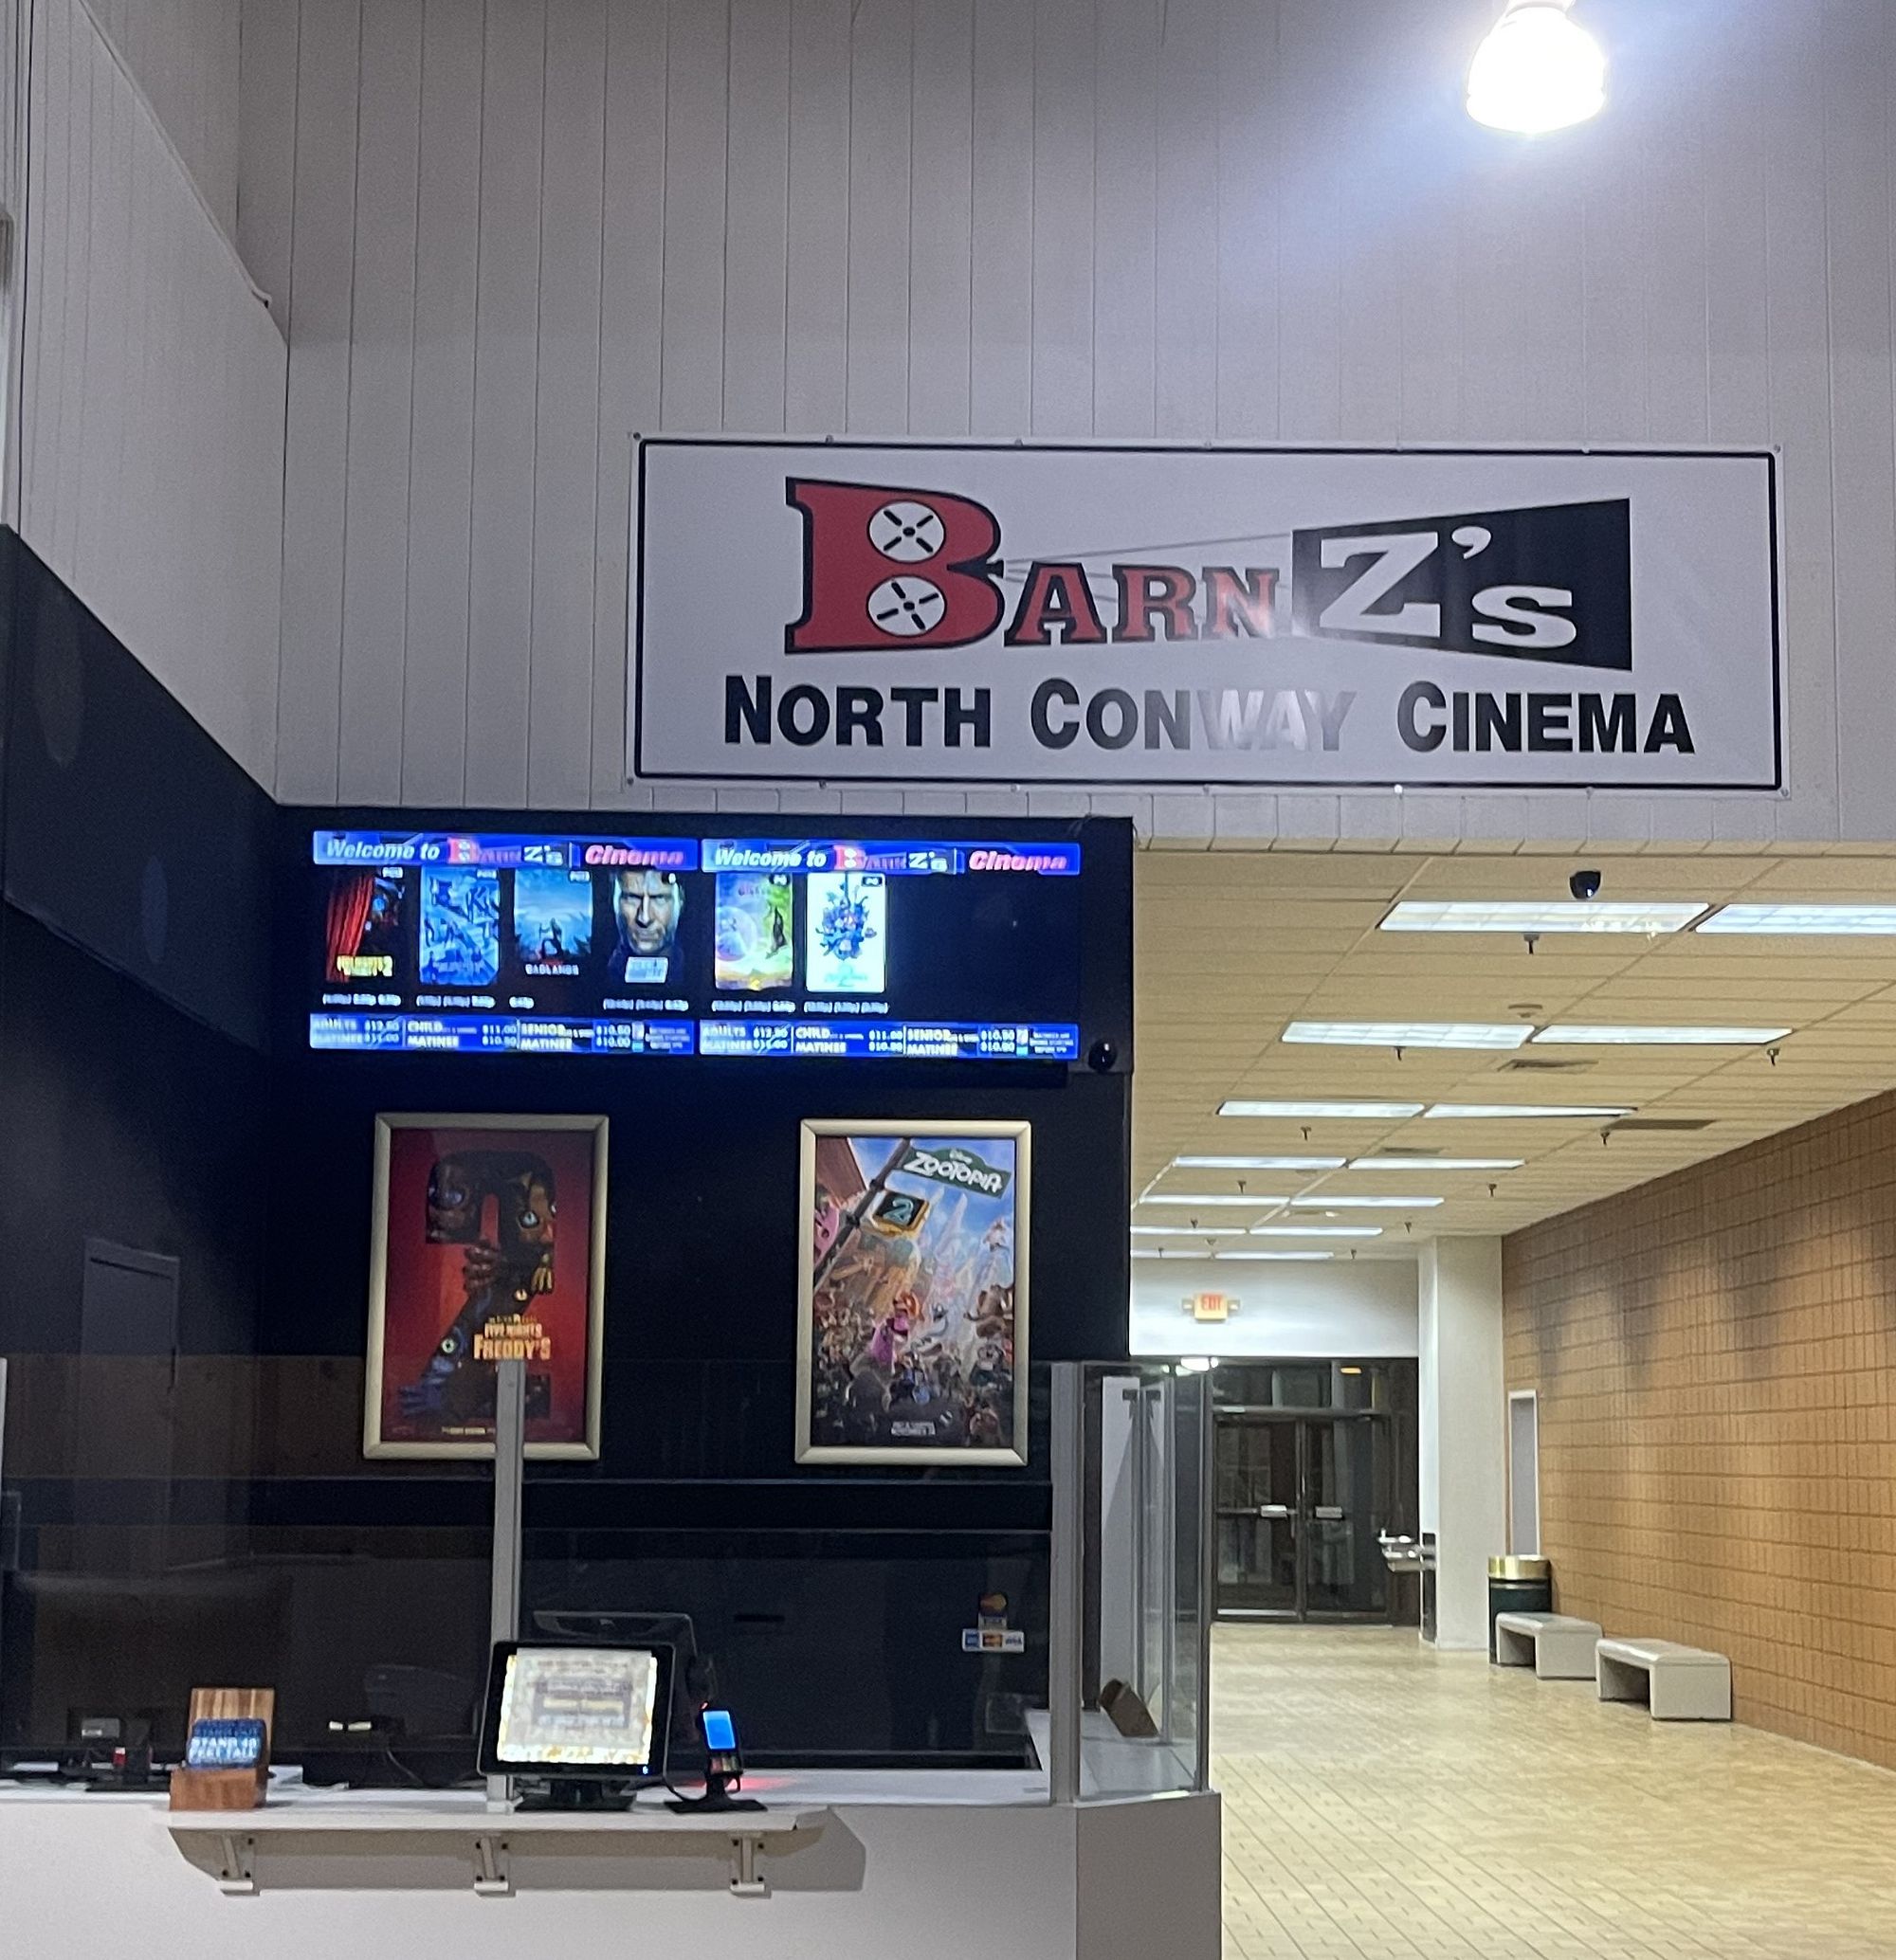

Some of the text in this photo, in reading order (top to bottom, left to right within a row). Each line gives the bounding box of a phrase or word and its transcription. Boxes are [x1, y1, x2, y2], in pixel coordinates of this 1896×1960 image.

[723, 674, 1697, 754] NORTH CONWAY CINEMA
[326, 838, 415, 860] Welcome
[419, 843, 441, 861] to
[584, 844, 684, 866] Cinema
[715, 847, 803, 867] Welcome
[806, 850, 828, 868] to
[968, 850, 1067, 871] Cinema
[407, 1021, 444, 1033] CHILD
[794, 1025, 830, 1039] CHILD
[907, 1028, 951, 1041] SENIOR
[903, 1151, 1003, 1193] ZOOTOPIA
[883, 1197, 914, 1225] 2
[1200, 1293, 1223, 1311] EXIT
[474, 1334, 551, 1360] FREDDY'S
